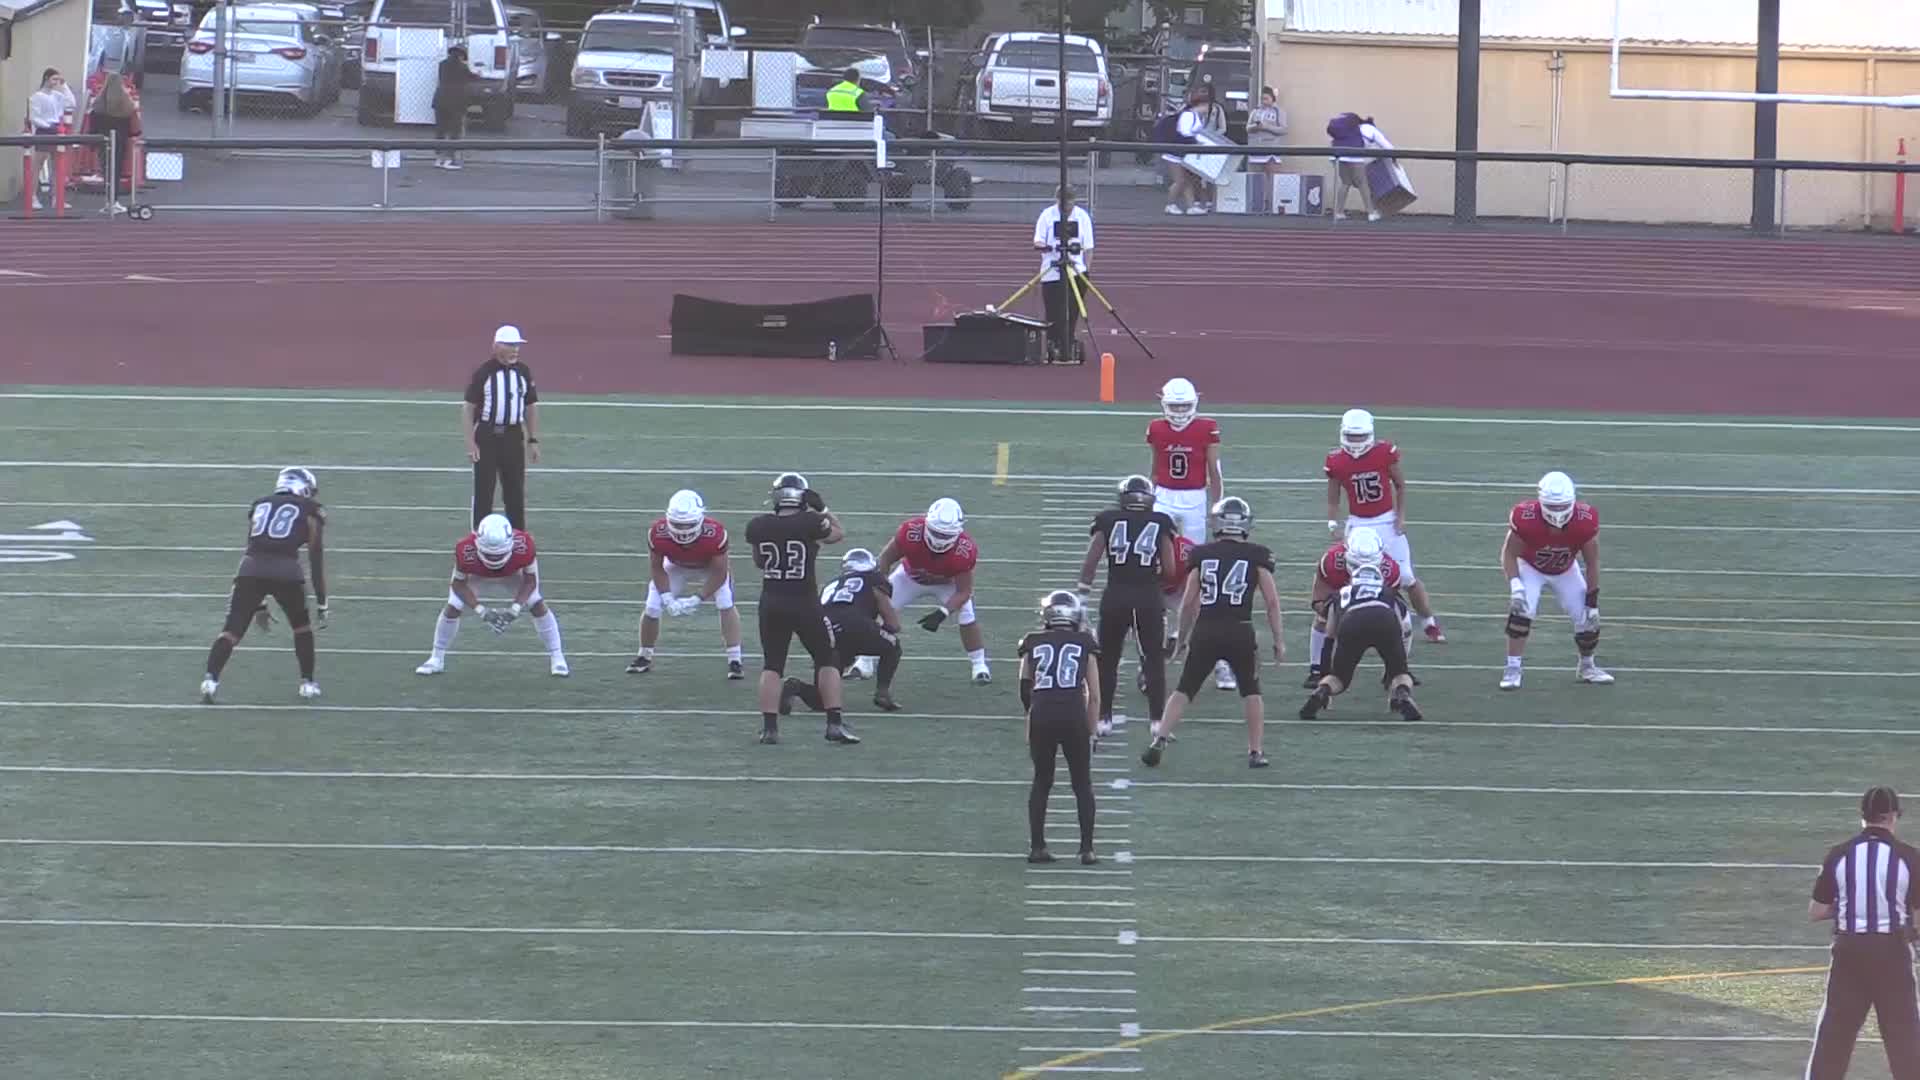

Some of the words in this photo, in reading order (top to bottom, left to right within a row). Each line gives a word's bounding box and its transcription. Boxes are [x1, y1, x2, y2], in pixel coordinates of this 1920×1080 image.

[1169, 452, 1188, 479] 9
[1352, 474, 1383, 504] 15
[759, 540, 806, 579] 23
[1109, 520, 1160, 566] 44
[1200, 559, 1249, 605] 54
[1033, 643, 1082, 689] 26
